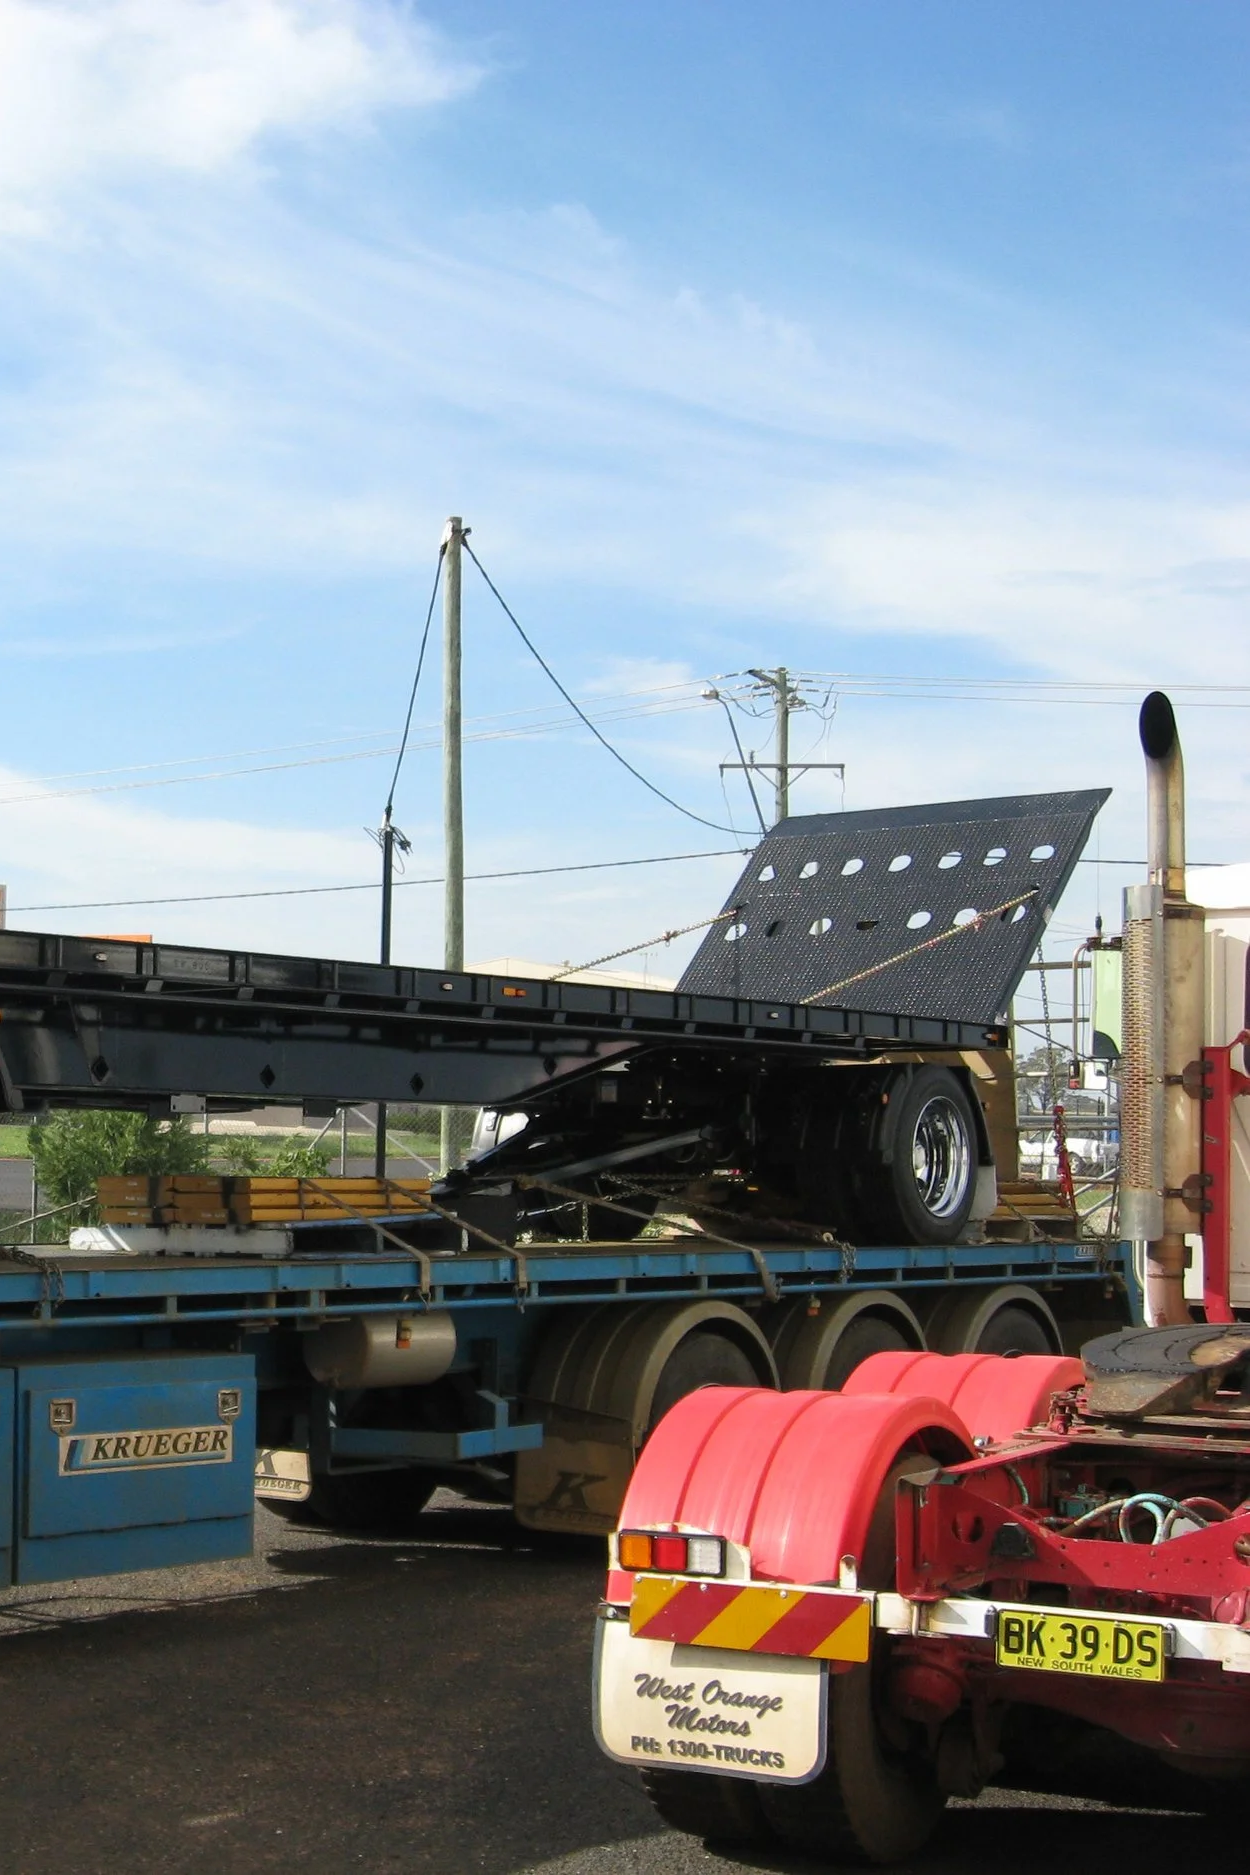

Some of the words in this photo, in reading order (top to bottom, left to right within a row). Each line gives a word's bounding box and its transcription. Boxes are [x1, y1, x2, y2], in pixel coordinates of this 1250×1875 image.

[91, 1429, 229, 1461] KRUEGER
[254, 1478, 302, 1491] RUEGER
[1017, 1656, 1045, 1668] NEW
[1051, 1660, 1094, 1673] SOUTH
[1100, 1664, 1143, 1678] WALES
[634, 1673, 696, 1703] West
[701, 1679, 784, 1719] Orange
[664, 1703, 752, 1737] Motors
[631, 1735, 663, 1755] PH:
[667, 1738, 786, 1769] 1300-TRUCKS
